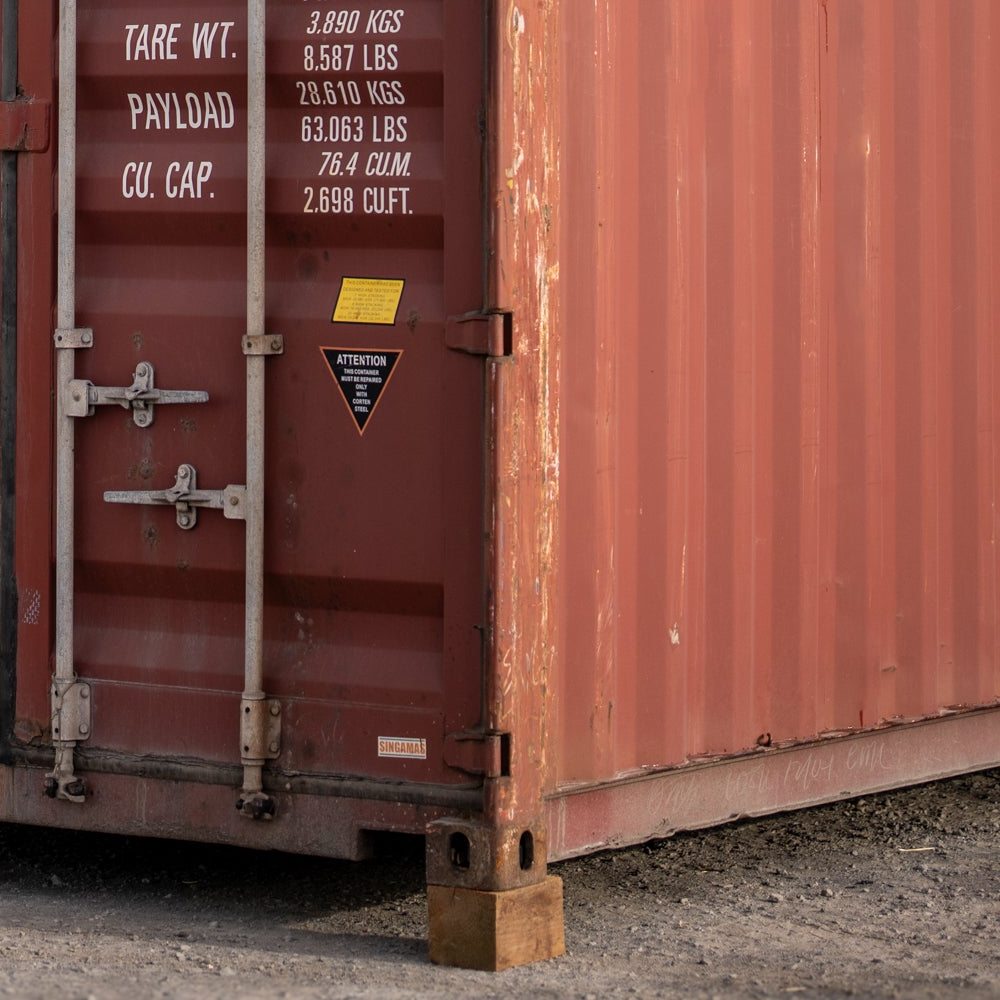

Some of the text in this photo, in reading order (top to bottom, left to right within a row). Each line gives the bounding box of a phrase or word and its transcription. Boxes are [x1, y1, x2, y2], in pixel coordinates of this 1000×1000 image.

[306, 9, 405, 34] 3,890 KGS
[125, 21, 237, 61] TARE WT.
[304, 44, 398, 71] 8,587 LBS
[366, 80, 406, 105] KGS
[127, 90, 235, 130] PAYLOAD
[301, 115, 408, 142] 63,063 LBS
[318, 151, 412, 176] 76.4 CU.M.
[122, 161, 215, 198] CU. CAP.
[303, 186, 413, 214] 2,698 CU.FT.
[336, 354, 387, 366] ATTENTION
[380, 741, 425, 754] SINGAMAS
